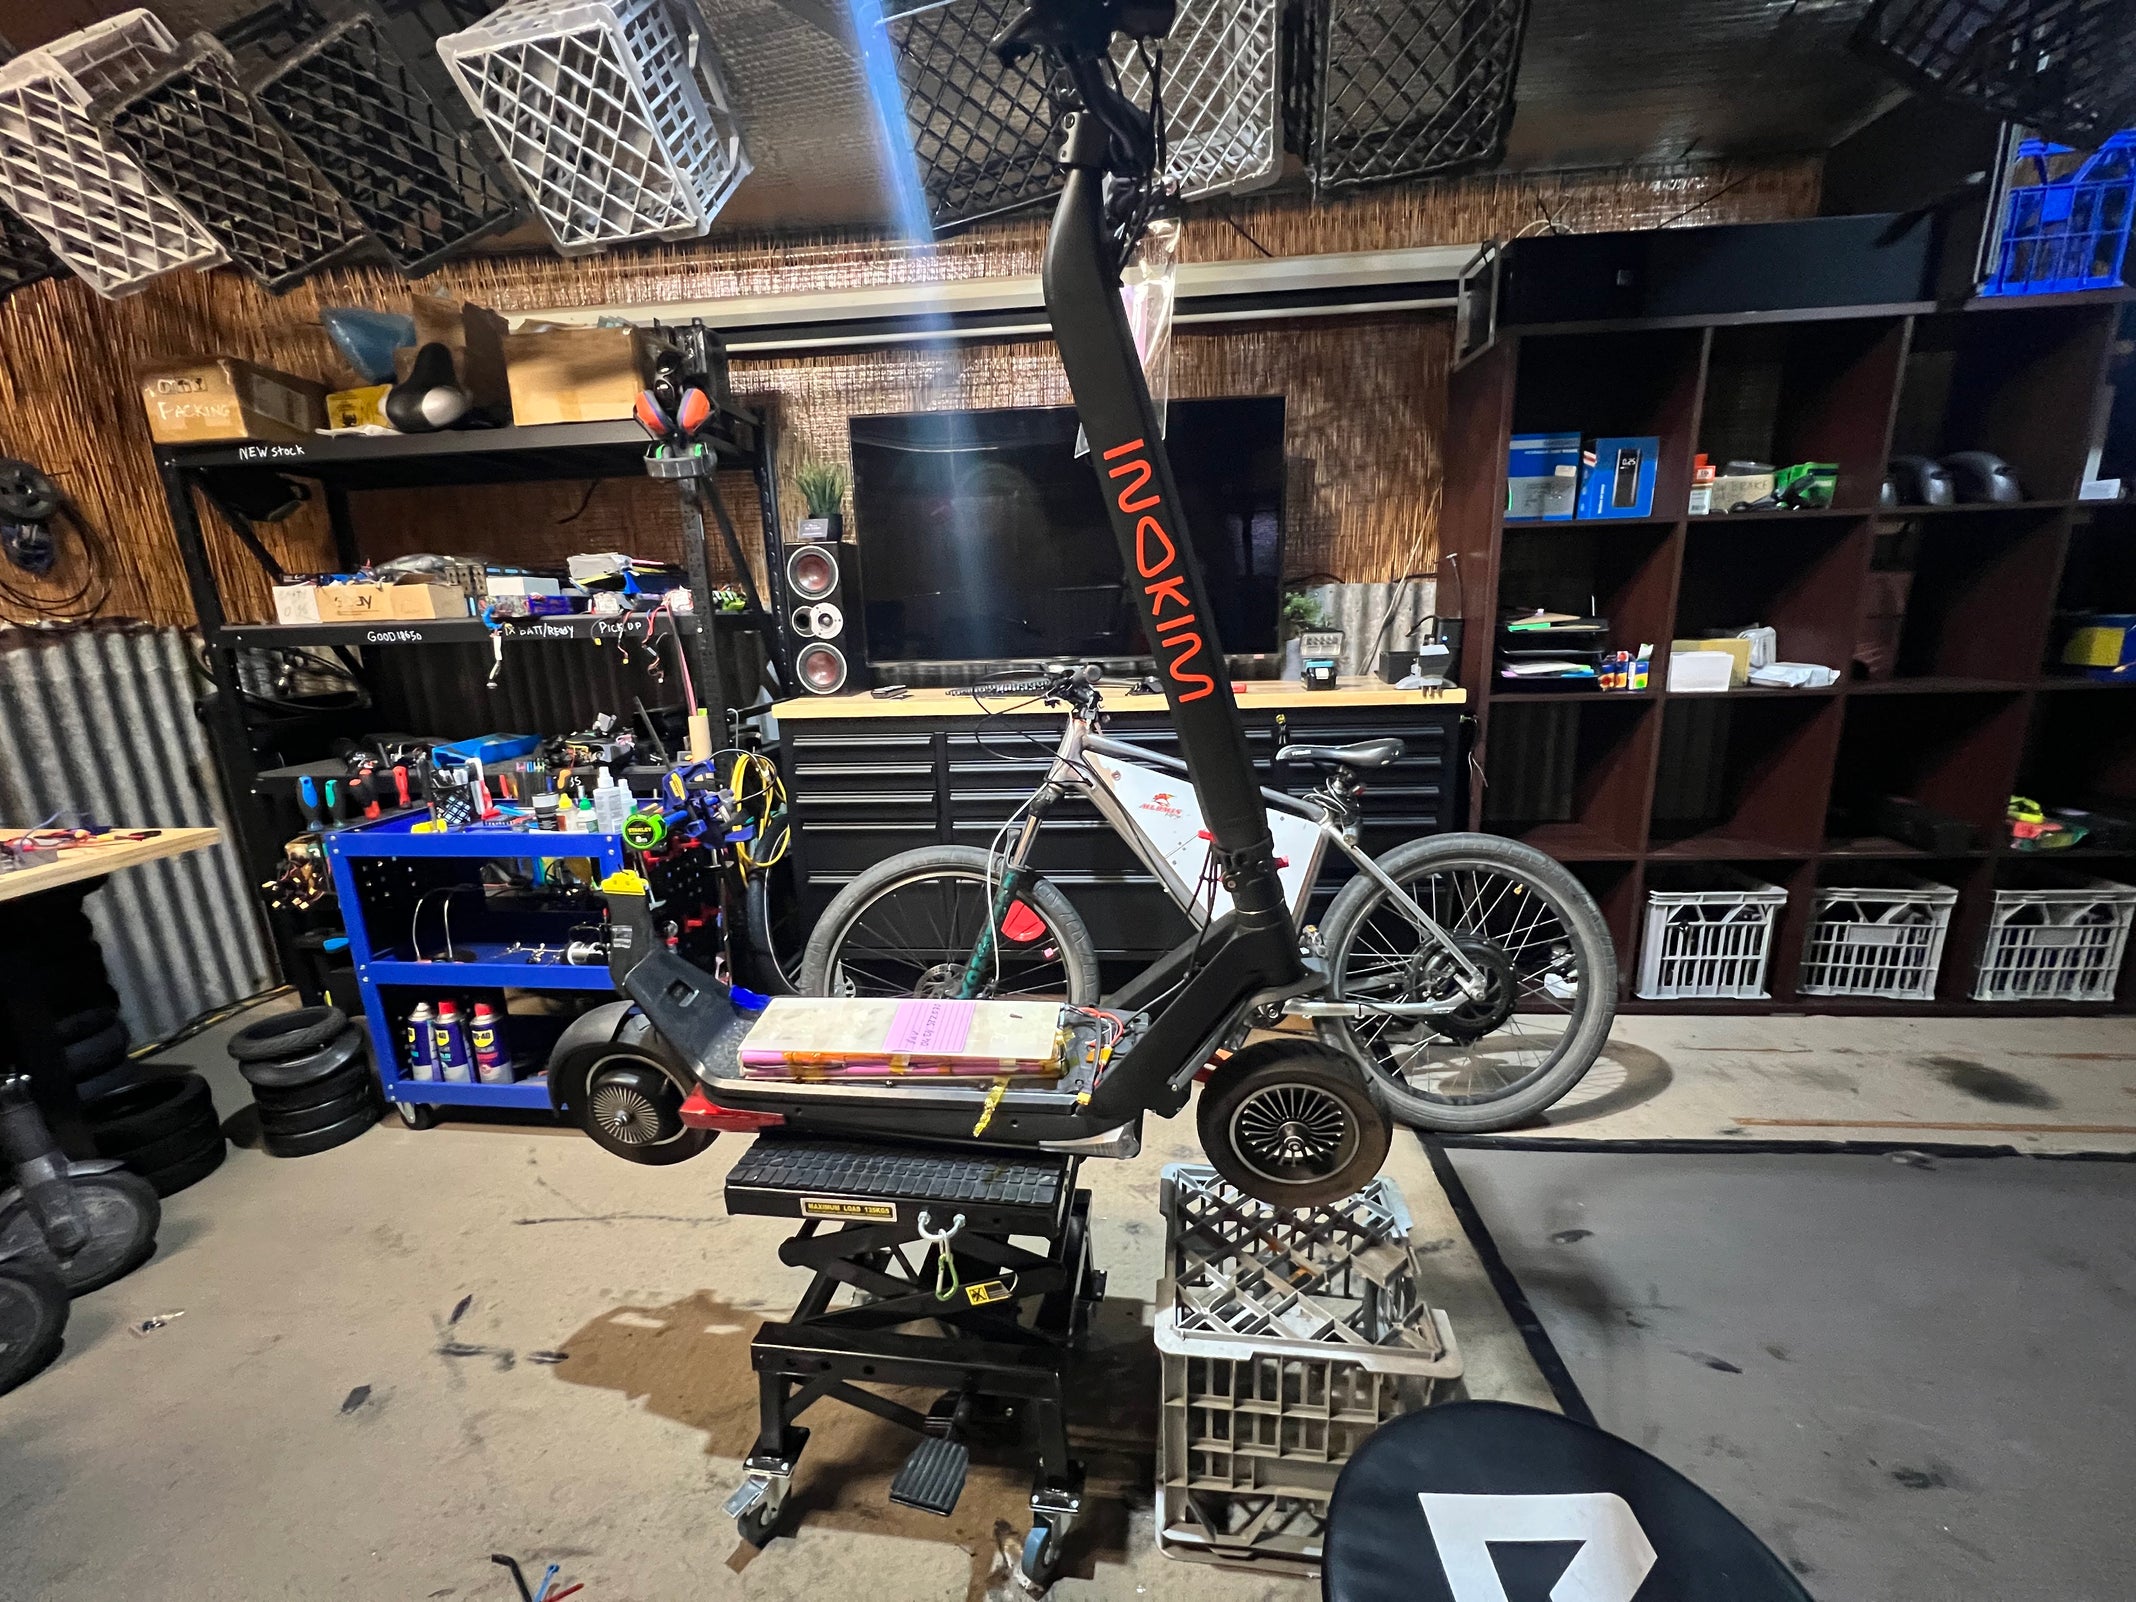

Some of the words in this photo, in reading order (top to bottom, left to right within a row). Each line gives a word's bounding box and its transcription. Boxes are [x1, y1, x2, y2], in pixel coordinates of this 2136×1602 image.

[238, 446, 269, 461] NEW
[1103, 438, 1215, 704] INOKIN
[367, 630, 396, 642] GOOD
[808, 1203, 841, 1212] MAXIMUM
[843, 1204, 861, 1213] LOAD
